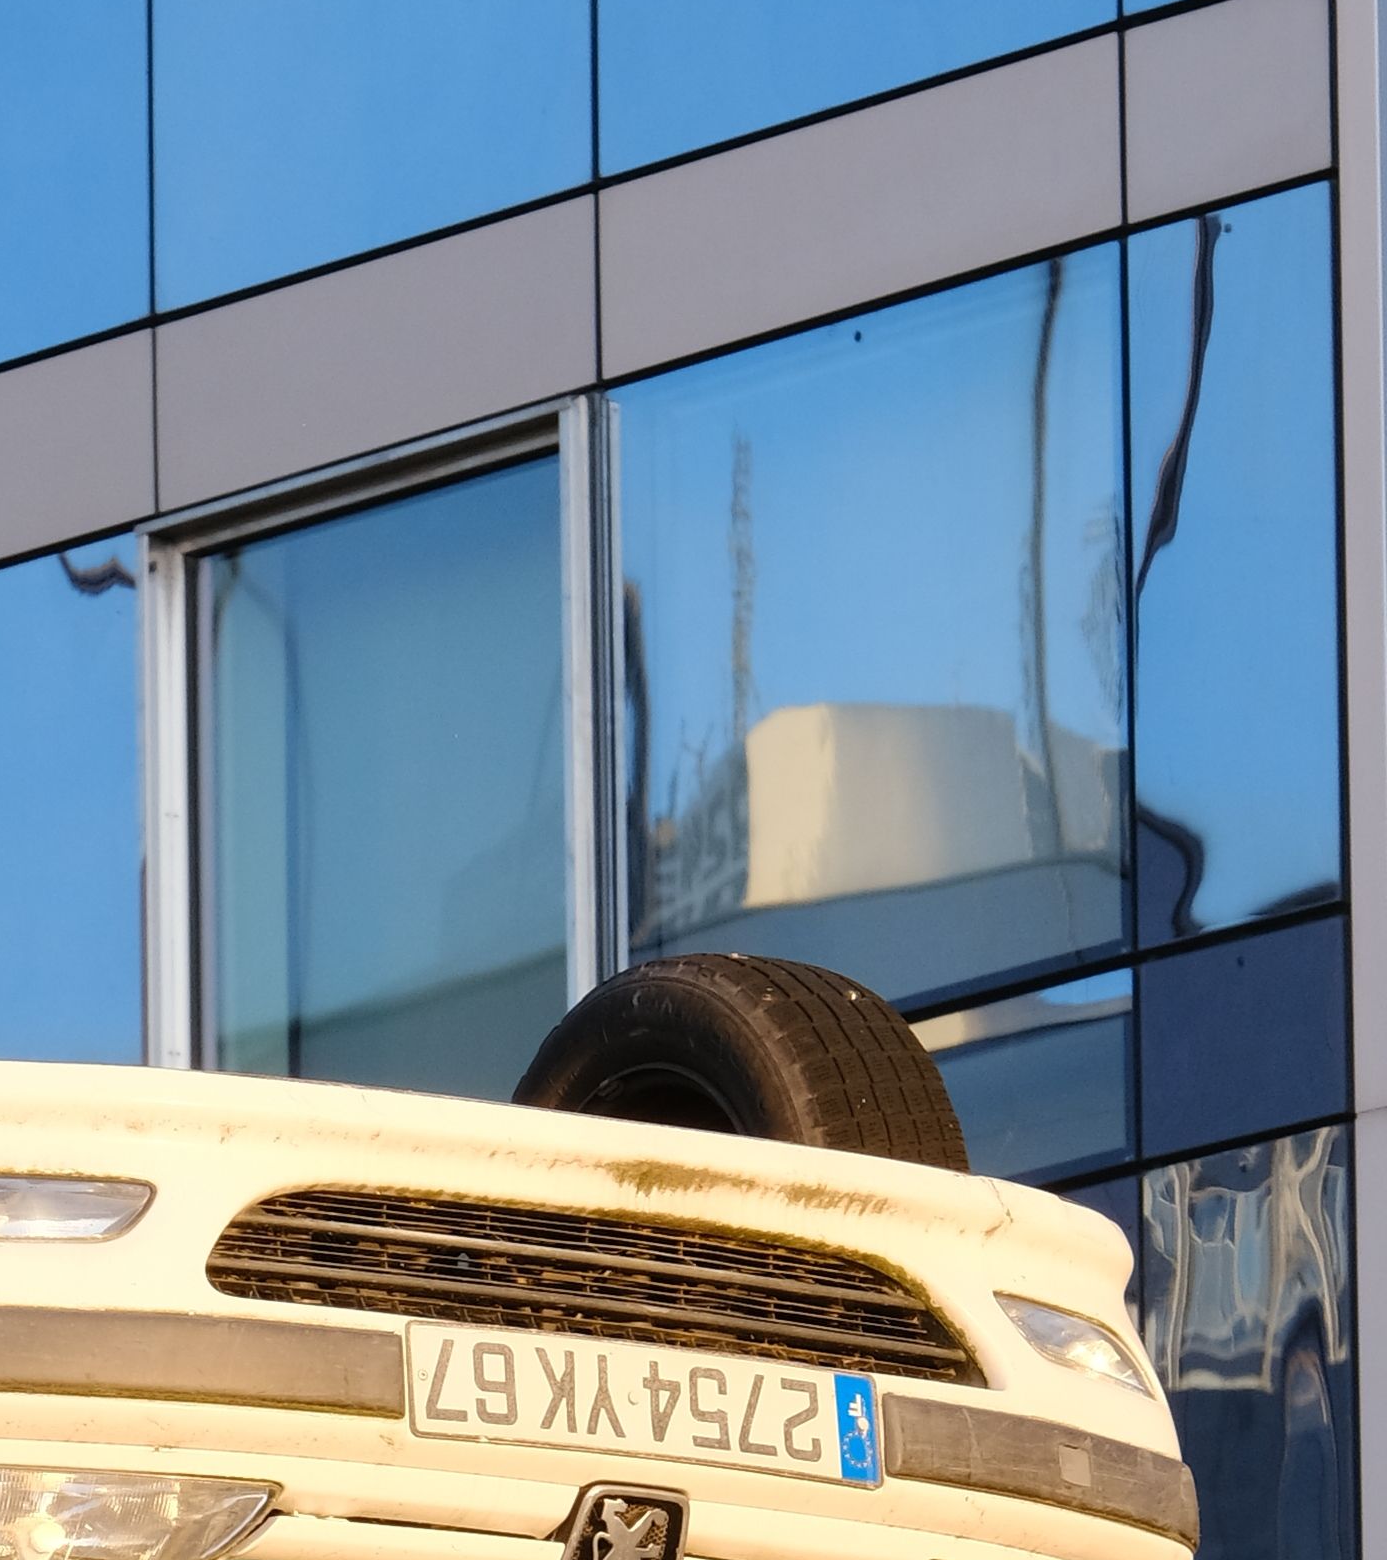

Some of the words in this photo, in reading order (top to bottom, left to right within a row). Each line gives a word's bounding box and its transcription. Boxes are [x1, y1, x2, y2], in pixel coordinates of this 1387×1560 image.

[426, 1338, 517, 1426] 67
[535, 1347, 625, 1438] YK
[643, 1361, 822, 1462] 2754
[849, 1394, 862, 1417] F
